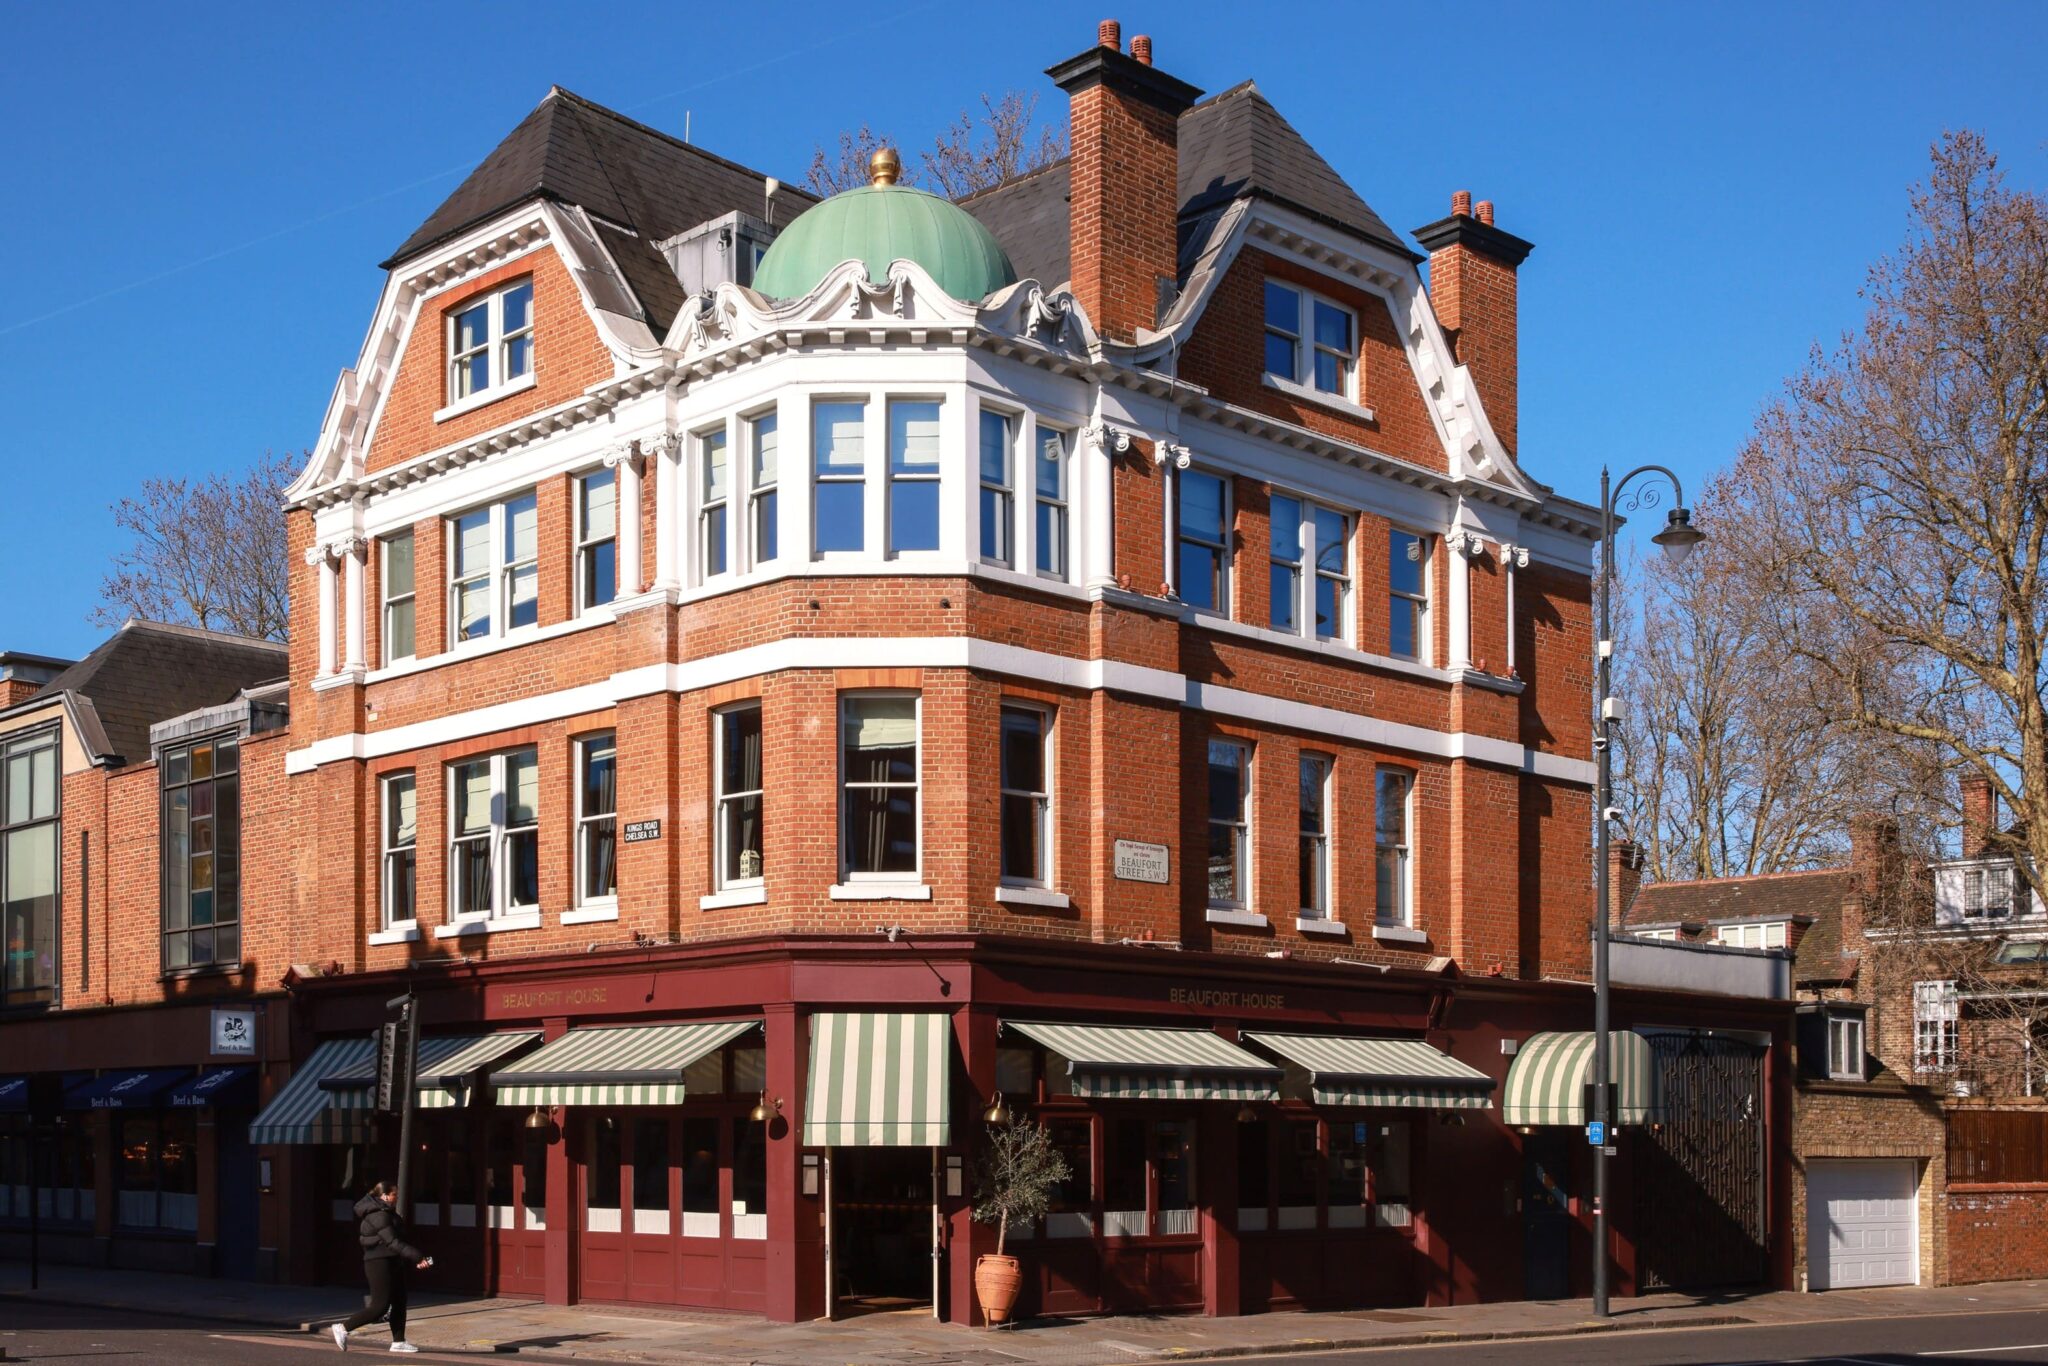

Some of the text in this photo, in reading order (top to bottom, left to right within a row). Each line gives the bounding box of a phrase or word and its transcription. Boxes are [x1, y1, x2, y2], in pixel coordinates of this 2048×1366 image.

[627, 821, 657, 832] KINGS ROAD
[625, 830, 647, 841] CHELSEA
[1121, 857, 1162, 870] BEAUFORT
[503, 988, 608, 1009] BEAUFORT HOUSE
[1169, 988, 1285, 1009] BEAUFORT HOUSE
